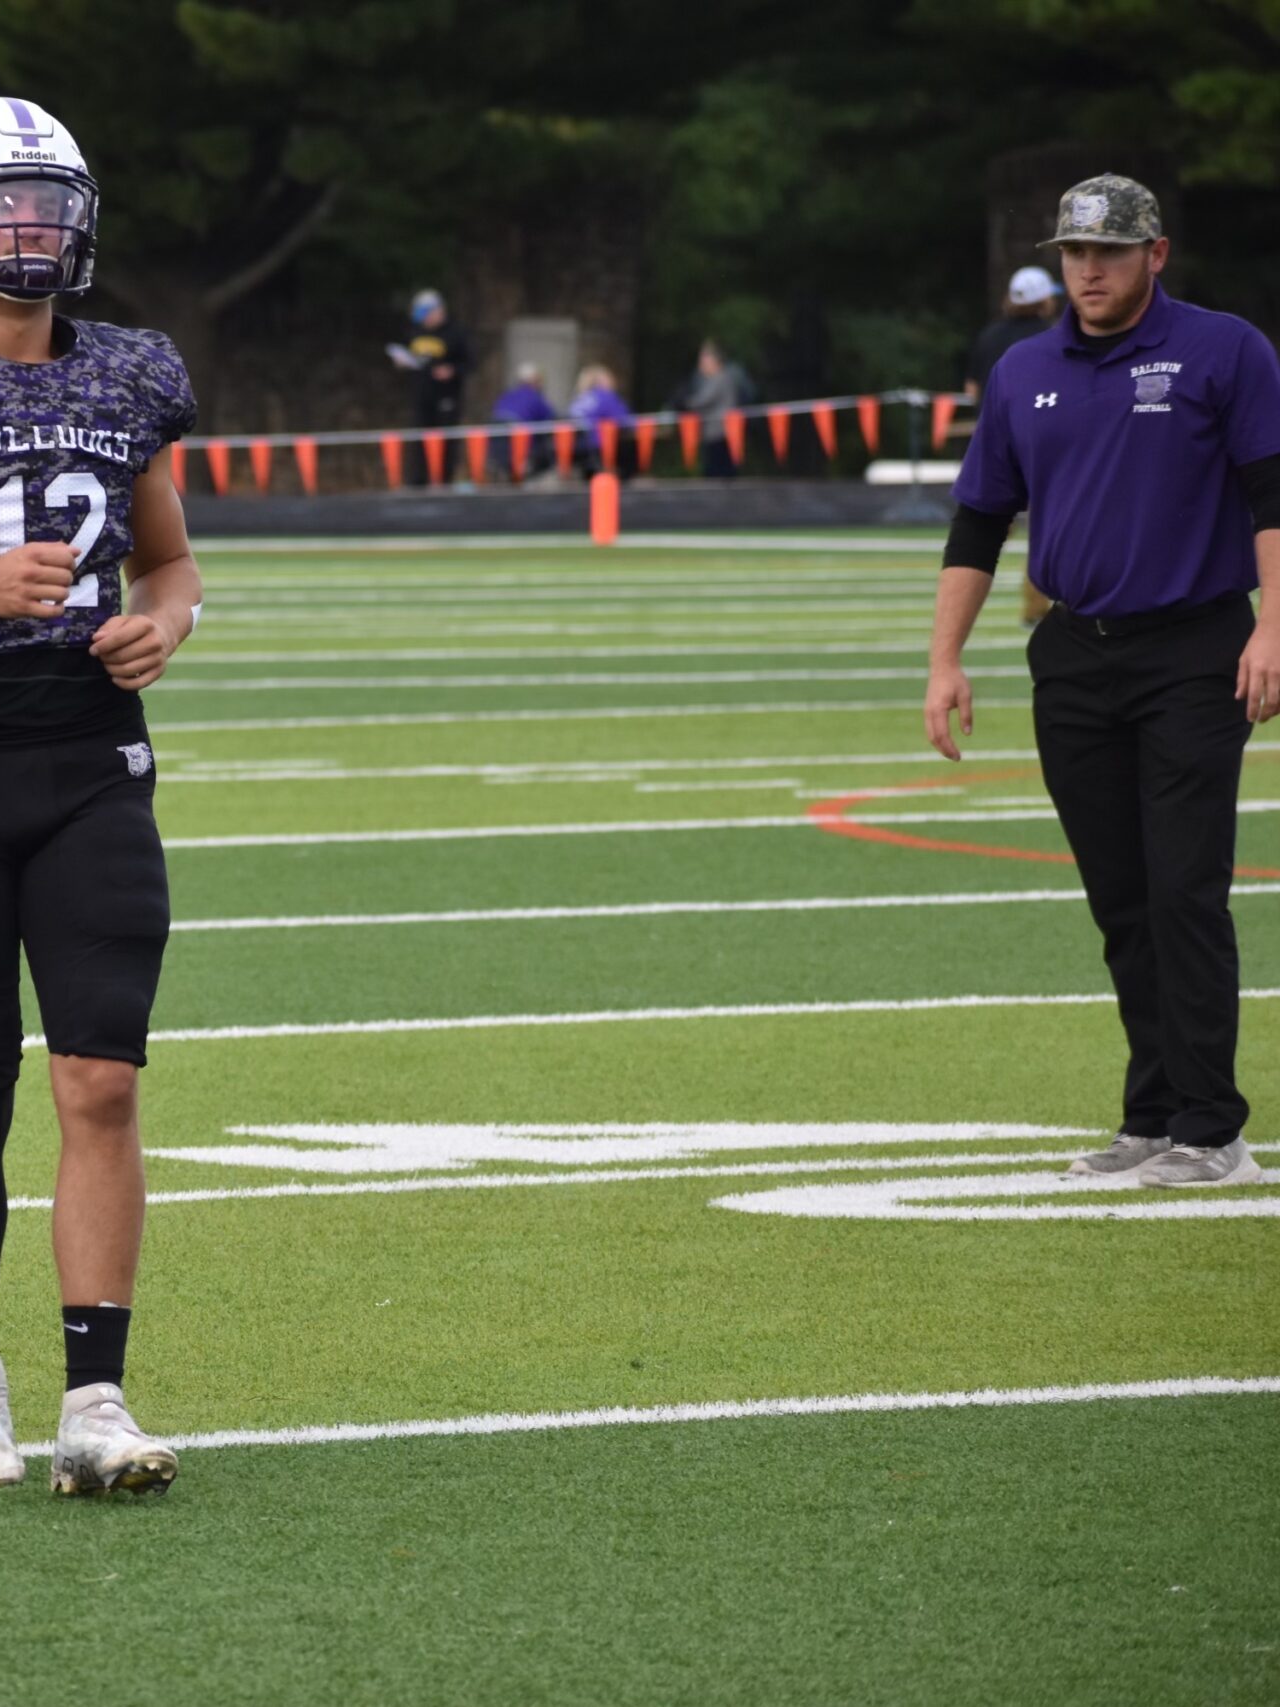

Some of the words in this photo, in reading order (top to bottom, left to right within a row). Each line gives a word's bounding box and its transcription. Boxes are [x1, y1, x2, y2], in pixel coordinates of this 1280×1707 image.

[11, 150, 57, 162] Riddell
[1130, 361, 1182, 378] BALDWIN
[1133, 403, 1172, 413] FOOTBALL
